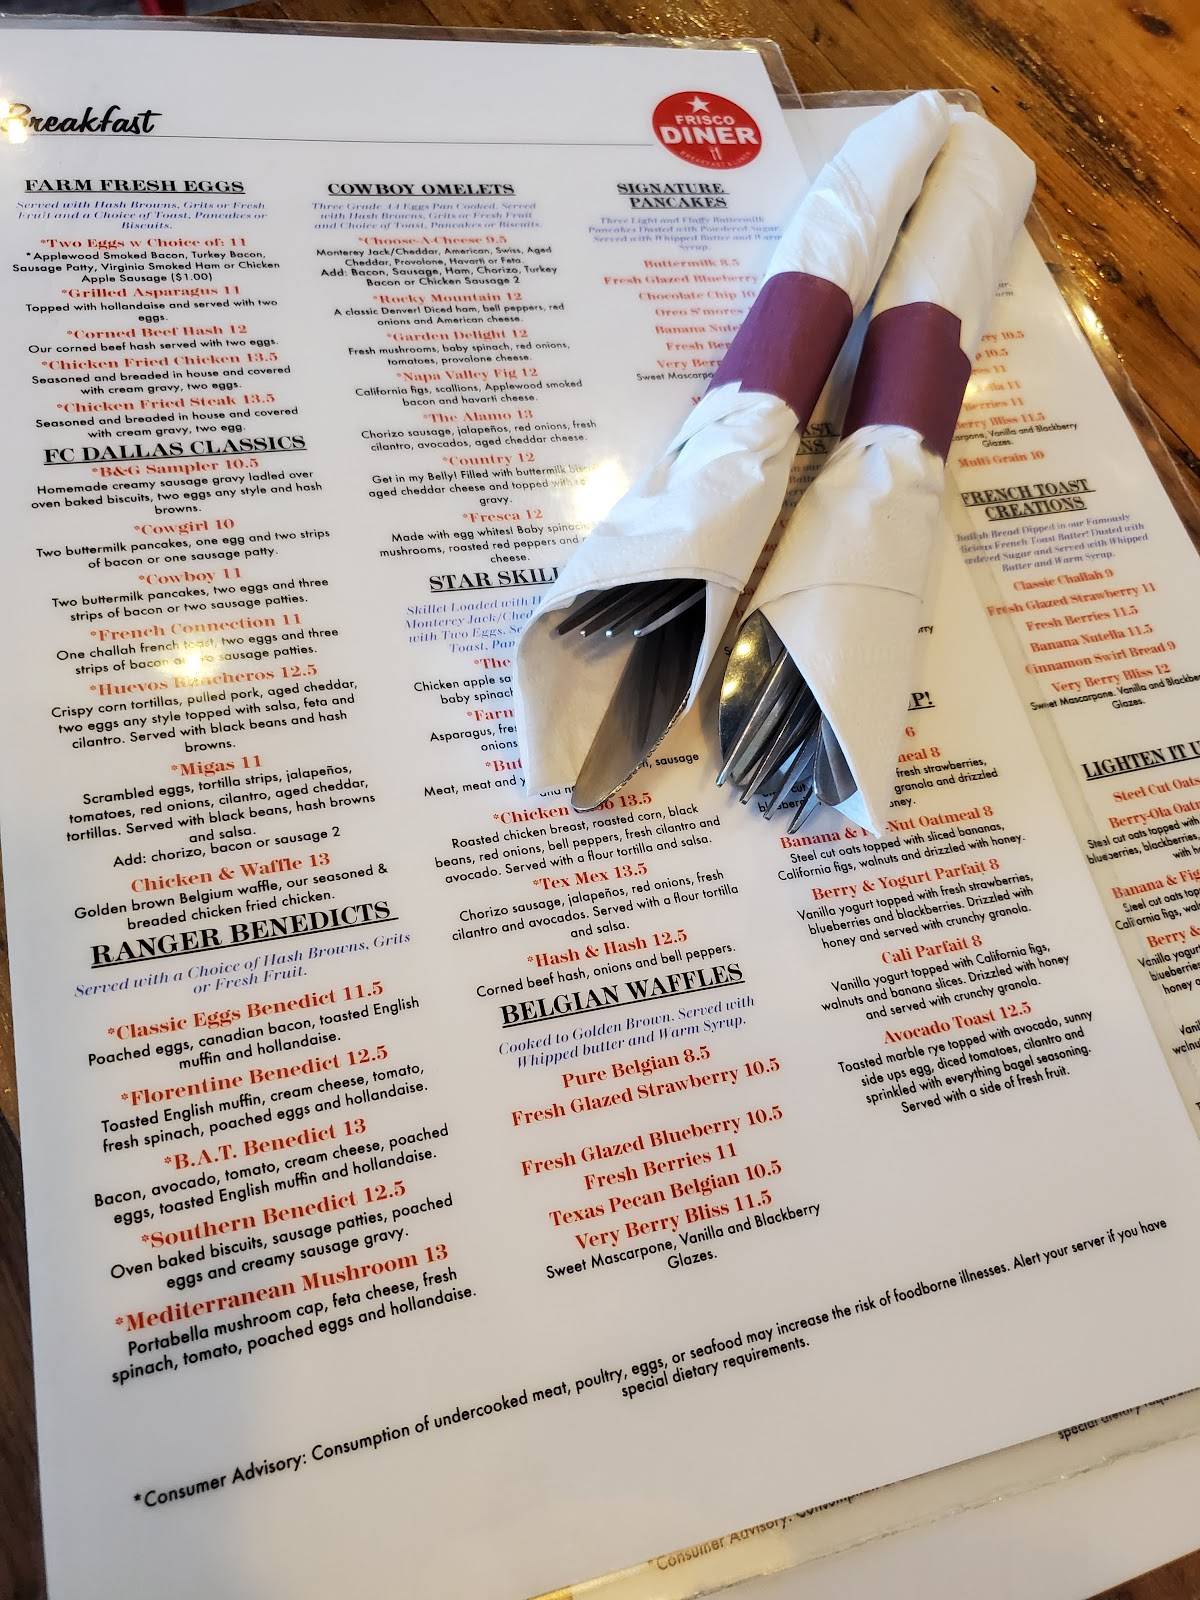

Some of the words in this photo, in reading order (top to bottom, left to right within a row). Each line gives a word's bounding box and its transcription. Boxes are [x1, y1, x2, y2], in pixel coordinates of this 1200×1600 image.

[0, 103, 162, 134] Breakfast
[675, 115, 735, 125] FRISCO
[659, 126, 759, 145] DINER
[25, 179, 93, 191] FARM
[100, 179, 176, 191] FRESH
[184, 180, 244, 192] EGGS
[327, 183, 414, 195] COWBOY
[422, 183, 515, 195] OMELETS
[617, 183, 724, 194] SIGNATURE
[630, 197, 727, 208] PANCAKES
[87, 238, 123, 250] Eggs
[132, 239, 141, 247] w
[148, 238, 198, 247] Choice
[206, 238, 224, 247] of:
[231, 238, 246, 246] 11
[316, 248, 364, 258] Monterey
[367, 247, 441, 257] Jack/Cheddar,
[444, 247, 493, 255] American,
[495, 246, 524, 255] Swiss,
[526, 245, 552, 255] Aged
[12, 263, 62, 274] Sausage
[65, 263, 97, 274] Patty,
[100, 262, 145, 273] Virginia
[148, 260, 192, 270] Smoked
[194, 261, 220, 269] Ham
[238, 260, 280, 269] Chicken
[430, 292, 501, 303] Mountain
[506, 292, 522, 301] 12
[123, 356, 169, 368] Fried
[173, 354, 240, 365] Chicken
[247, 352, 278, 362] 13.5
[355, 386, 408, 397] California
[410, 384, 432, 396] figs,
[435, 383, 482, 393] scallions,
[484, 380, 543, 393] Applewood
[545, 378, 583, 388] smoked
[43, 448, 76, 463] FC
[82, 441, 183, 461] DALLAS
[189, 435, 306, 455] CLASSICS
[960, 485, 1034, 505] FRENCH
[1034, 479, 1089, 496] TOAST
[985, 496, 1085, 520] CREATIONS
[215, 518, 234, 530] 10
[429, 572, 493, 591] STAR
[1012, 577, 1056, 591] Classic
[1056, 570, 1105, 584] Challah
[1103, 568, 1114, 578] 9
[1030, 637, 1079, 652] Banana
[1080, 629, 1126, 645] Nutella
[1128, 624, 1153, 638] 11.5
[1081, 748, 1166, 778] LIGHTEN
[1167, 744, 1187, 760] IT
[82, 784, 154, 805] Scrambled
[158, 784, 194, 798] eggs,
[198, 775, 241, 791] tortilla
[245, 772, 282, 786] strips,
[285, 765, 352, 783] jalapeños,
[451, 831, 500, 849] Roasted
[503, 826, 547, 841] chicken
[549, 820, 589, 834] breast,
[591, 811, 634, 828] roasted
[637, 811, 666, 822] corn,
[667, 802, 699, 817] black
[130, 872, 213, 893] Chicken
[218, 866, 235, 881] &
[239, 857, 302, 877] Waffle
[309, 852, 330, 867] 13
[574, 871, 609, 885] Mex
[613, 862, 648, 879] 13.5
[811, 884, 857, 901] Berry
[862, 879, 875, 892] &
[877, 870, 932, 890] Yogurt
[933, 860, 987, 880] Parfait
[988, 858, 1000, 870] 8
[90, 928, 223, 965] RANGER
[228, 900, 391, 944] BENEDICTS
[193, 1009, 241, 1029] Eggs
[247, 989, 336, 1018] Benedict
[343, 980, 383, 1001] 11.5
[499, 984, 619, 1025] BELGIAN
[624, 962, 743, 1000] WAFFLES
[498, 1033, 551, 1055] Cooked
[556, 1033, 569, 1044] to
[572, 1023, 621, 1040] Golden
[626, 1013, 675, 1030] Brown.
[677, 1000, 722, 1020] Served
[725, 995, 754, 1011] with
[884, 1020, 951, 1044] Avocado
[951, 1008, 996, 1029] Toast
[999, 1001, 1031, 1019] 12.5
[837, 1052, 883, 1073] Toasted
[885, 1044, 925, 1063] marble
[927, 1043, 946, 1057] rye
[947, 1030, 987, 1051] topped
[987, 1025, 1011, 1040] with
[1013, 1016, 1062, 1035] avocado,
[1063, 1010, 1092, 1024] sunny
[561, 1070, 607, 1088] Pure
[611, 1055, 680, 1078] Belgian
[683, 1045, 710, 1063] 8.5
[575, 1229, 620, 1249] Very
[624, 1215, 679, 1238] Berry
[684, 1203, 730, 1224] Bliss
[734, 1189, 772, 1212] 11.5
[300, 1254, 419, 1291] Mushroom
[424, 1243, 448, 1263] 13
[128, 1324, 209, 1356] Portabella
[213, 1309, 292, 1336] mushroom
[296, 1302, 328, 1317] cap,
[332, 1292, 361, 1308] feta
[365, 1281, 419, 1300] cheese,
[422, 1266, 457, 1287] fresh
[231, 1453, 307, 1484] Advisory:
[311, 1426, 410, 1461] Consumption
[414, 1414, 430, 1433] of
[433, 1388, 528, 1428] undercooked
[532, 1381, 571, 1402] meat,
[575, 1368, 628, 1395] poultry,
[631, 1358, 668, 1377] eggs,
[671, 1351, 686, 1364] or
[689, 1331, 743, 1359] seafood
[745, 1327, 773, 1344] may
[775, 1313, 829, 1335] increase
[831, 1304, 852, 1320] the
[854, 1295, 877, 1314] risk
[879, 1289, 891, 1307] of
[892, 1277, 957, 1303] foodborne
[958, 1263, 1010, 1284] illnesses.
[1013, 1251, 1041, 1270] Alert
[1042, 1246, 1068, 1265] your
[1071, 1236, 1105, 1253] server
[1106, 1228, 1116, 1243] if
[1116, 1227, 1138, 1244] you
[1138, 1219, 1167, 1234] have
[621, 1370, 669, 1399] special
[672, 1361, 719, 1383] dietary
[722, 1336, 810, 1369] requirements.
